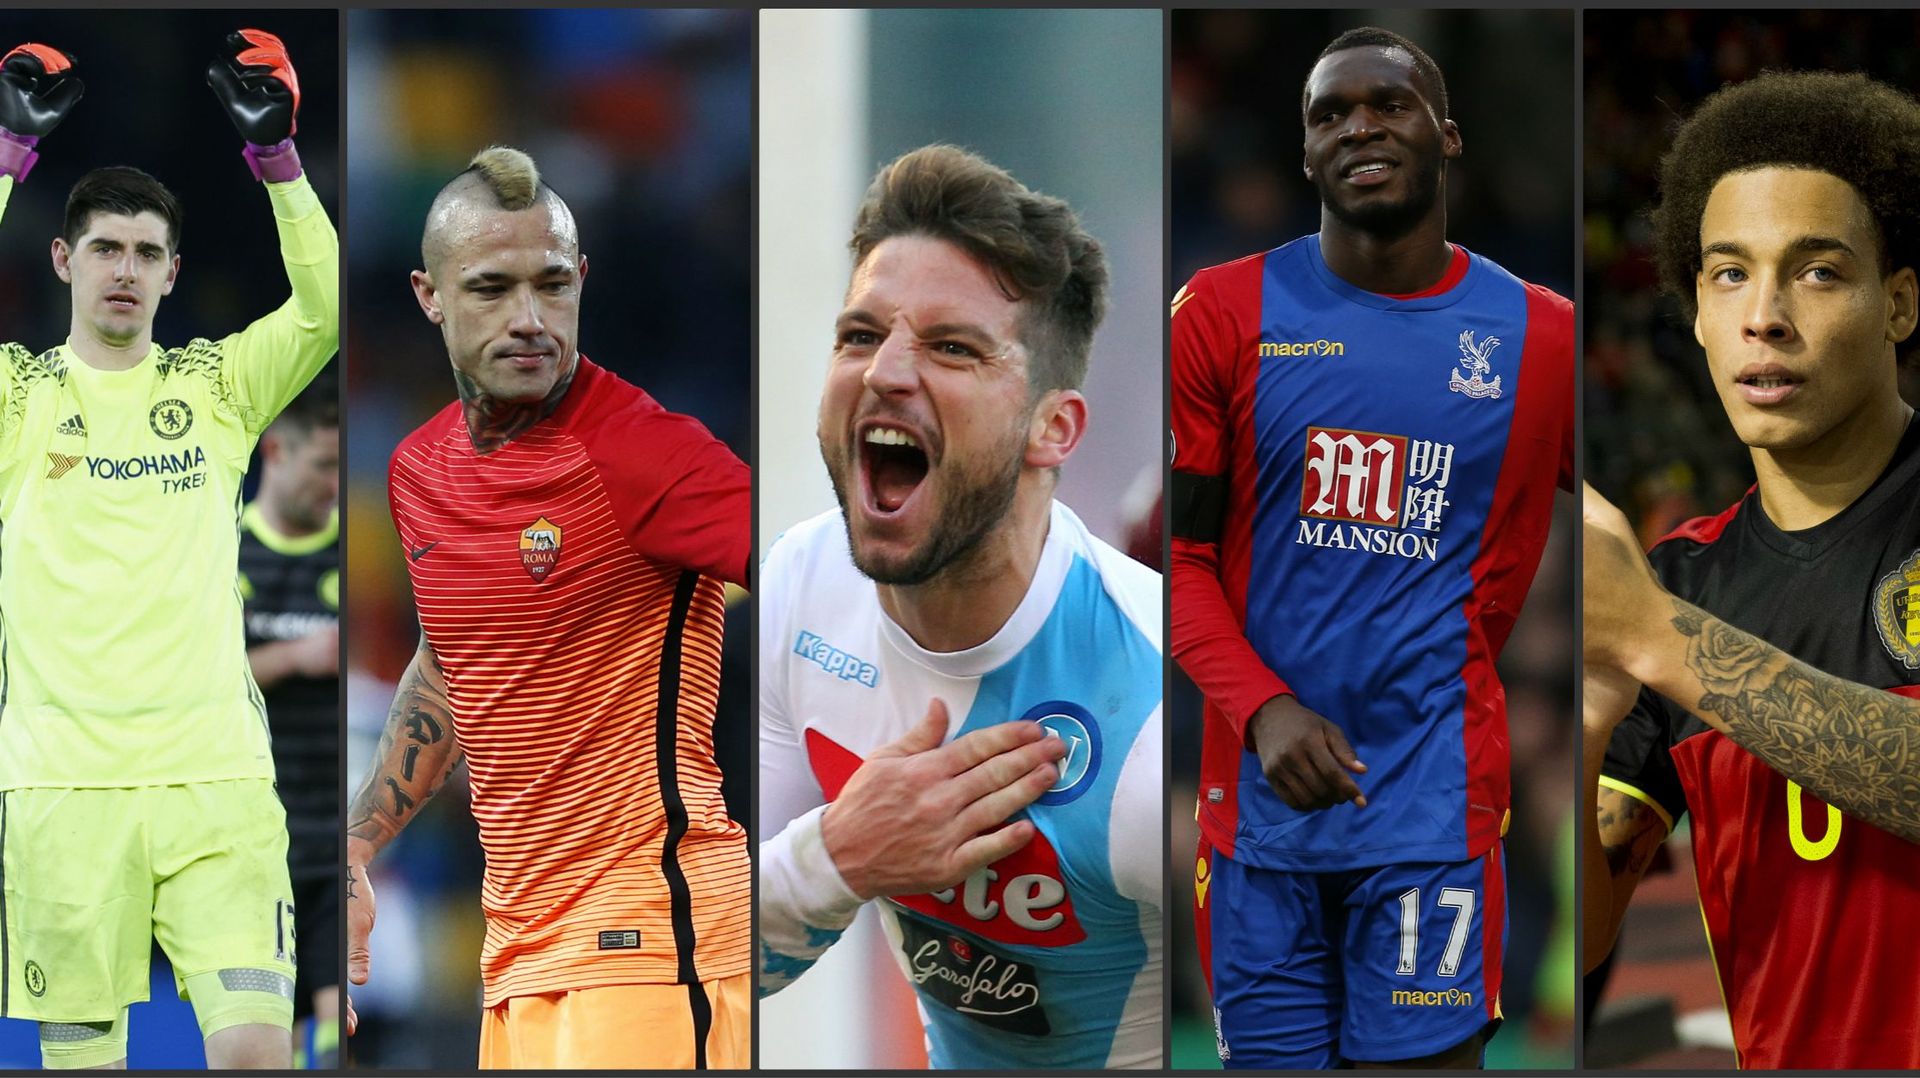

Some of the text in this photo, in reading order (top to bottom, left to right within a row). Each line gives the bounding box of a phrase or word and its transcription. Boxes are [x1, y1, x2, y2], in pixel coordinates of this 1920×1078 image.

[1258, 339, 1344, 357] macron
[85, 446, 206, 480] YOKOHAMA
[523, 553, 554, 564] ROMA
[1296, 520, 1440, 561] MANSION
[793, 630, 878, 688] Kappa
[930, 863, 1066, 932] te
[1395, 887, 1476, 977] 17
[913, 940, 1039, 1016] Garofalo
[1391, 988, 1472, 1006] macron
